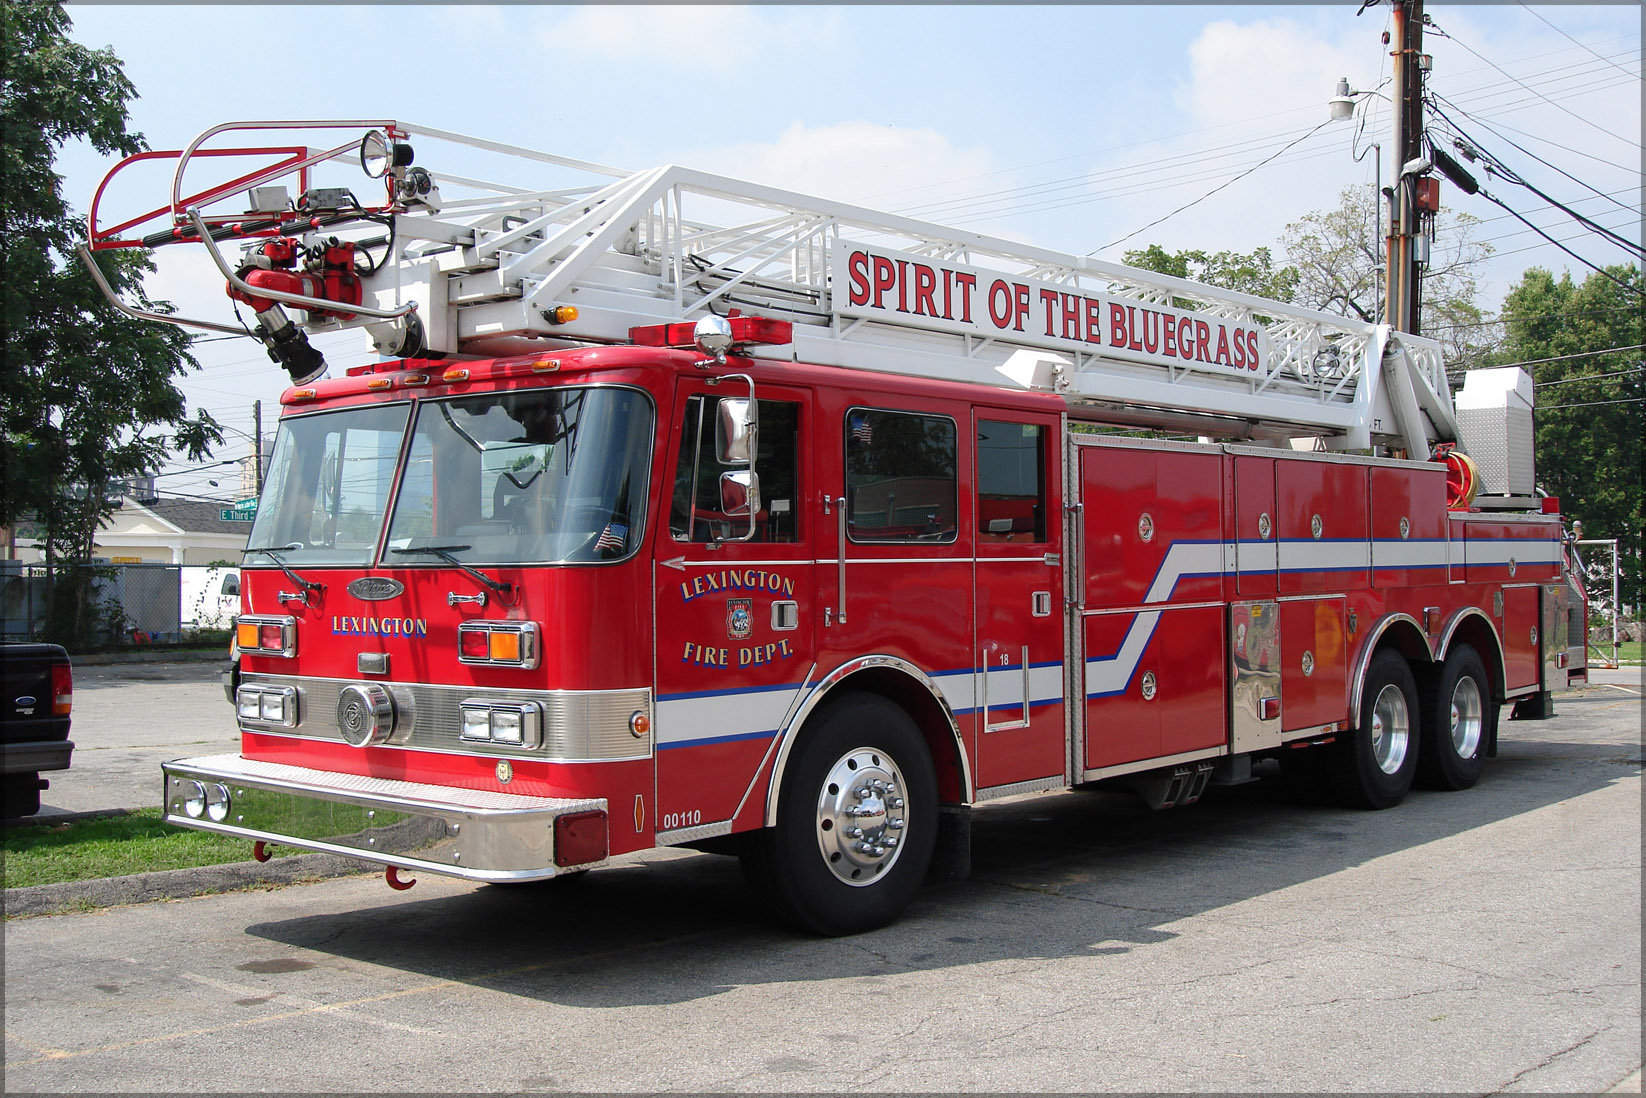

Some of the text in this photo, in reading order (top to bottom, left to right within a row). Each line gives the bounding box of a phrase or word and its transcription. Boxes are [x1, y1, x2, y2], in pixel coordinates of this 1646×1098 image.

[849, 250, 1260, 372] SPIRIT OF THE BLUEGRASS
[221, 510, 228, 520] E
[231, 510, 249, 520] Third
[681, 570, 795, 603] LEXINGTON
[332, 616, 427, 638] LEXINGTON
[682, 638, 794, 669] FIRE DEPT.
[1000, 653, 1009, 666] 18
[663, 809, 701, 829] 00110
